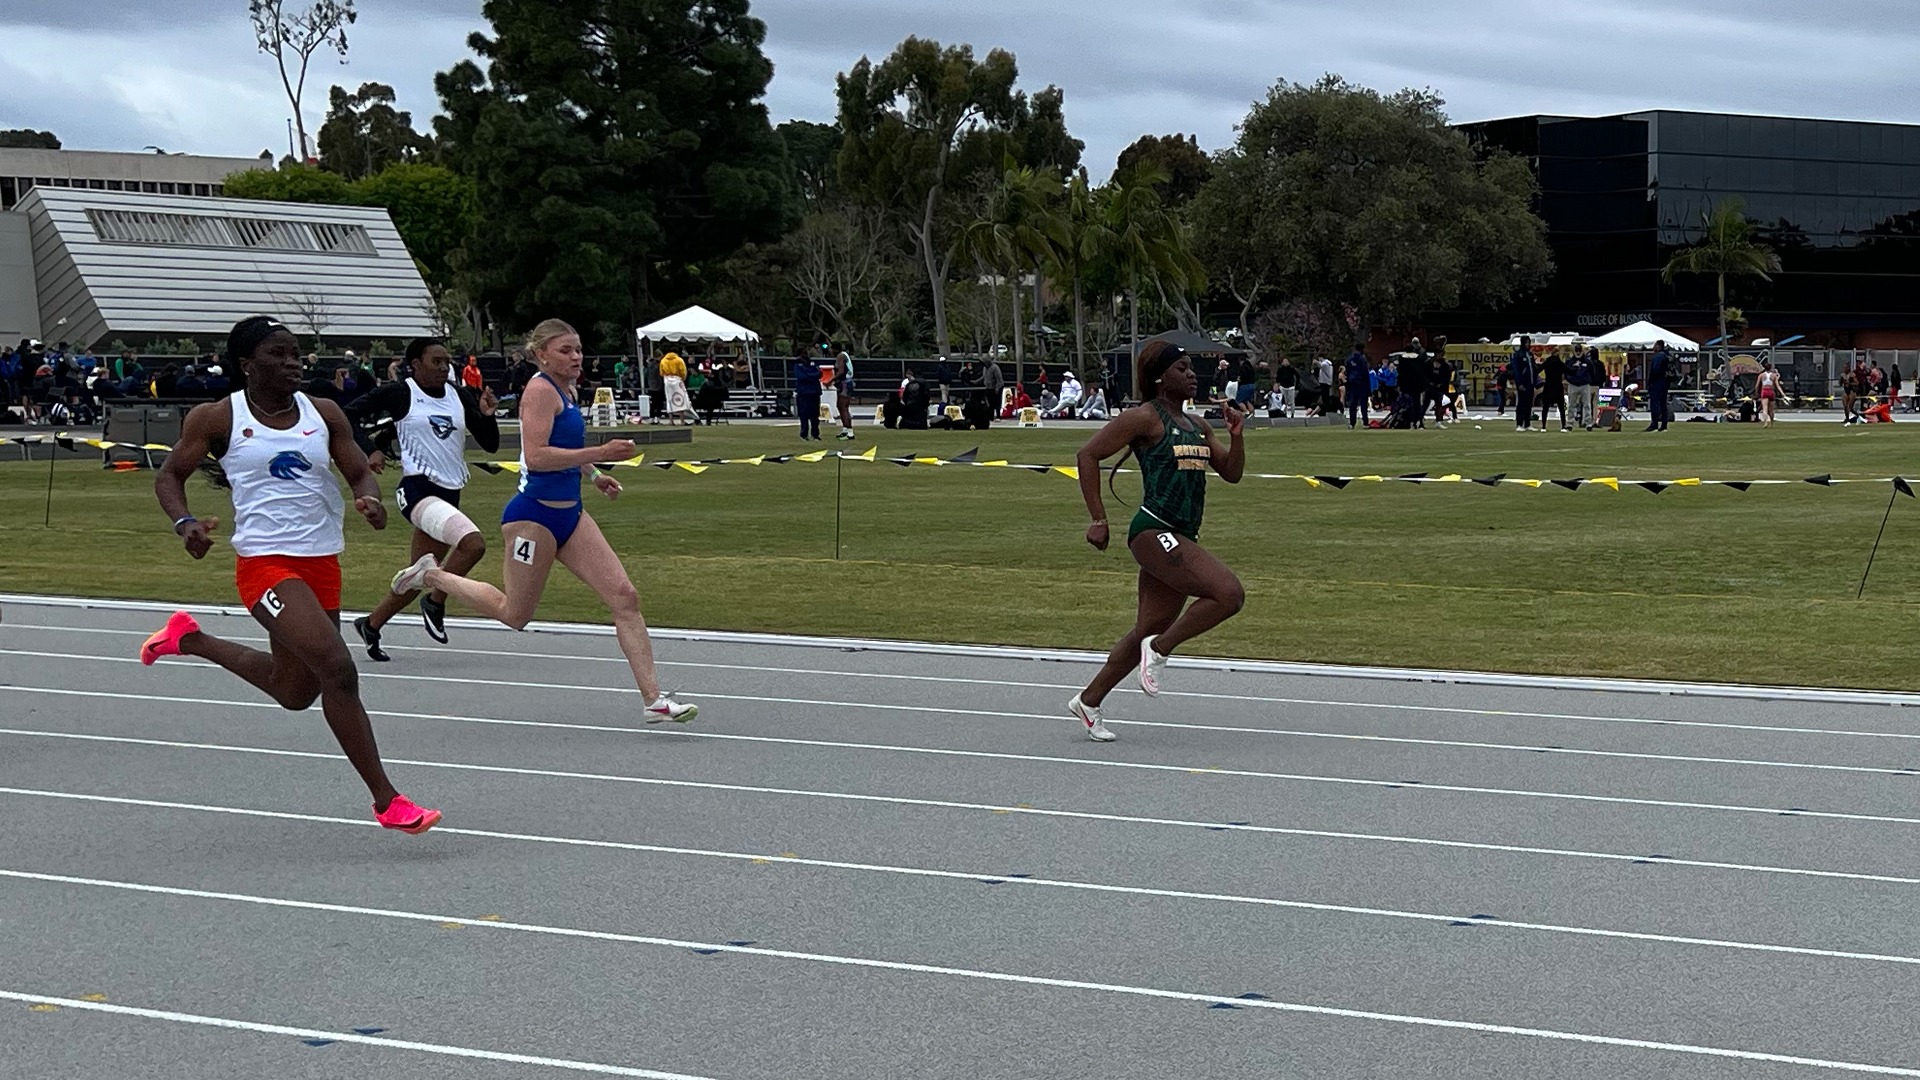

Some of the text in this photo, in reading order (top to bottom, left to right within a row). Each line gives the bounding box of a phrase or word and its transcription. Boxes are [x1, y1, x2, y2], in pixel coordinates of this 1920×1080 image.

[1577, 314, 1607, 326] COLLEGE
[1608, 313, 1618, 325] OF
[1159, 534, 1173, 550] 3
[517, 541, 531, 562] 4
[266, 590, 283, 610] 6
